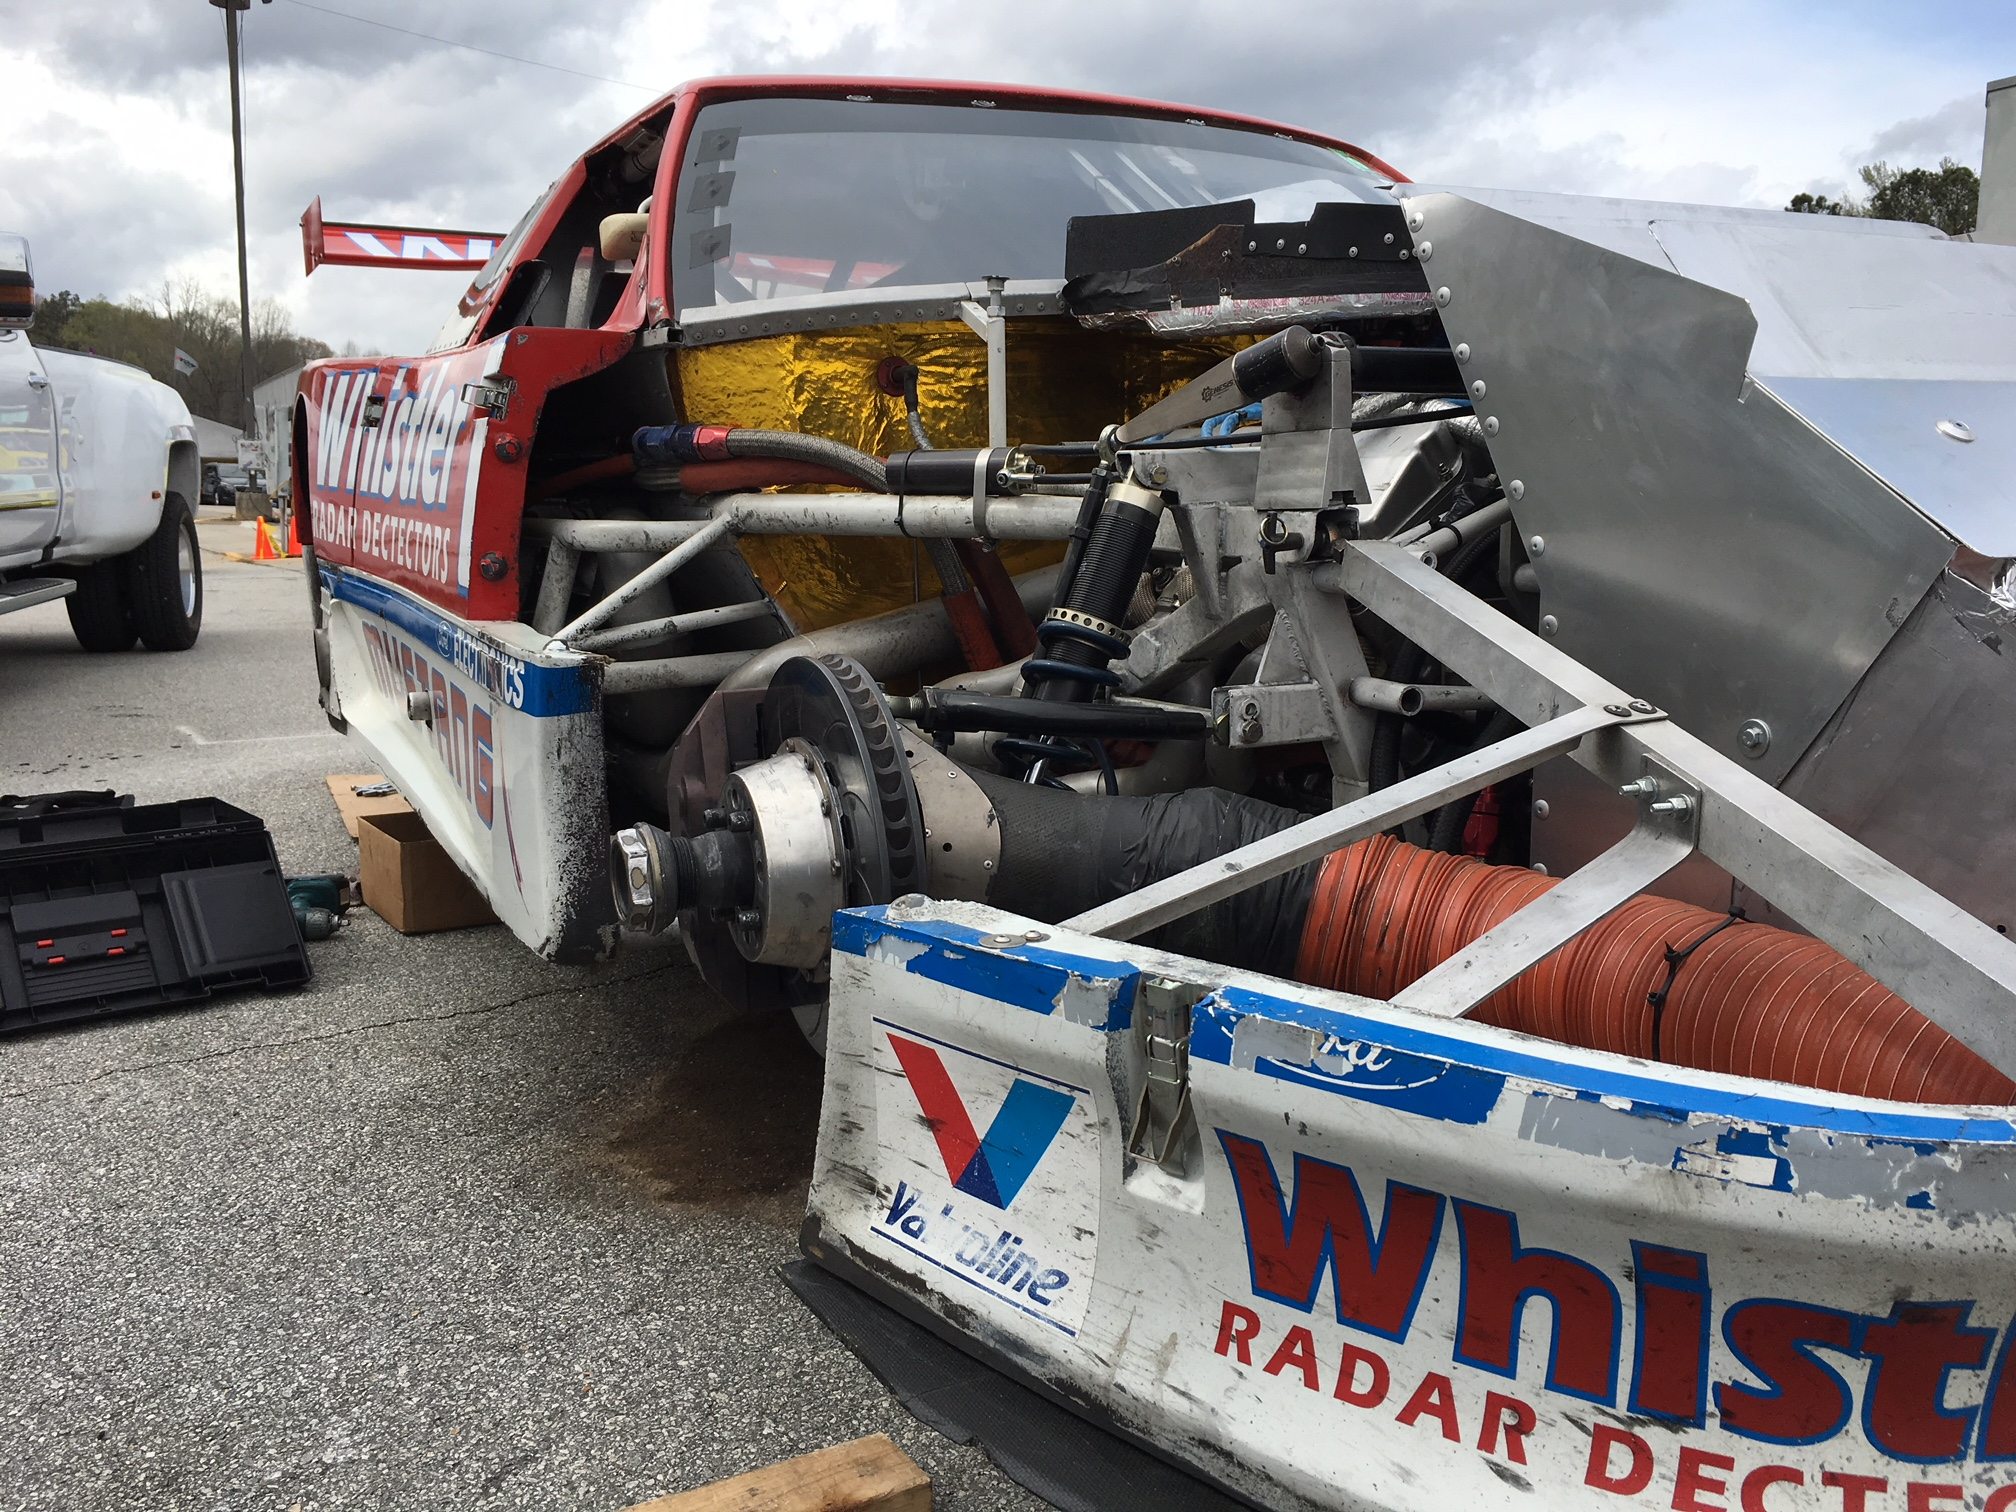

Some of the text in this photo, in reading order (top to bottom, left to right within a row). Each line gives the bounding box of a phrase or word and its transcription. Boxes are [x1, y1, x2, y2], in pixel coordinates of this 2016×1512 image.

[316, 356, 472, 511] Whistler
[312, 500, 450, 585] RADAR DECTECTORS
[1214, 1300, 1537, 1466] RADAR
